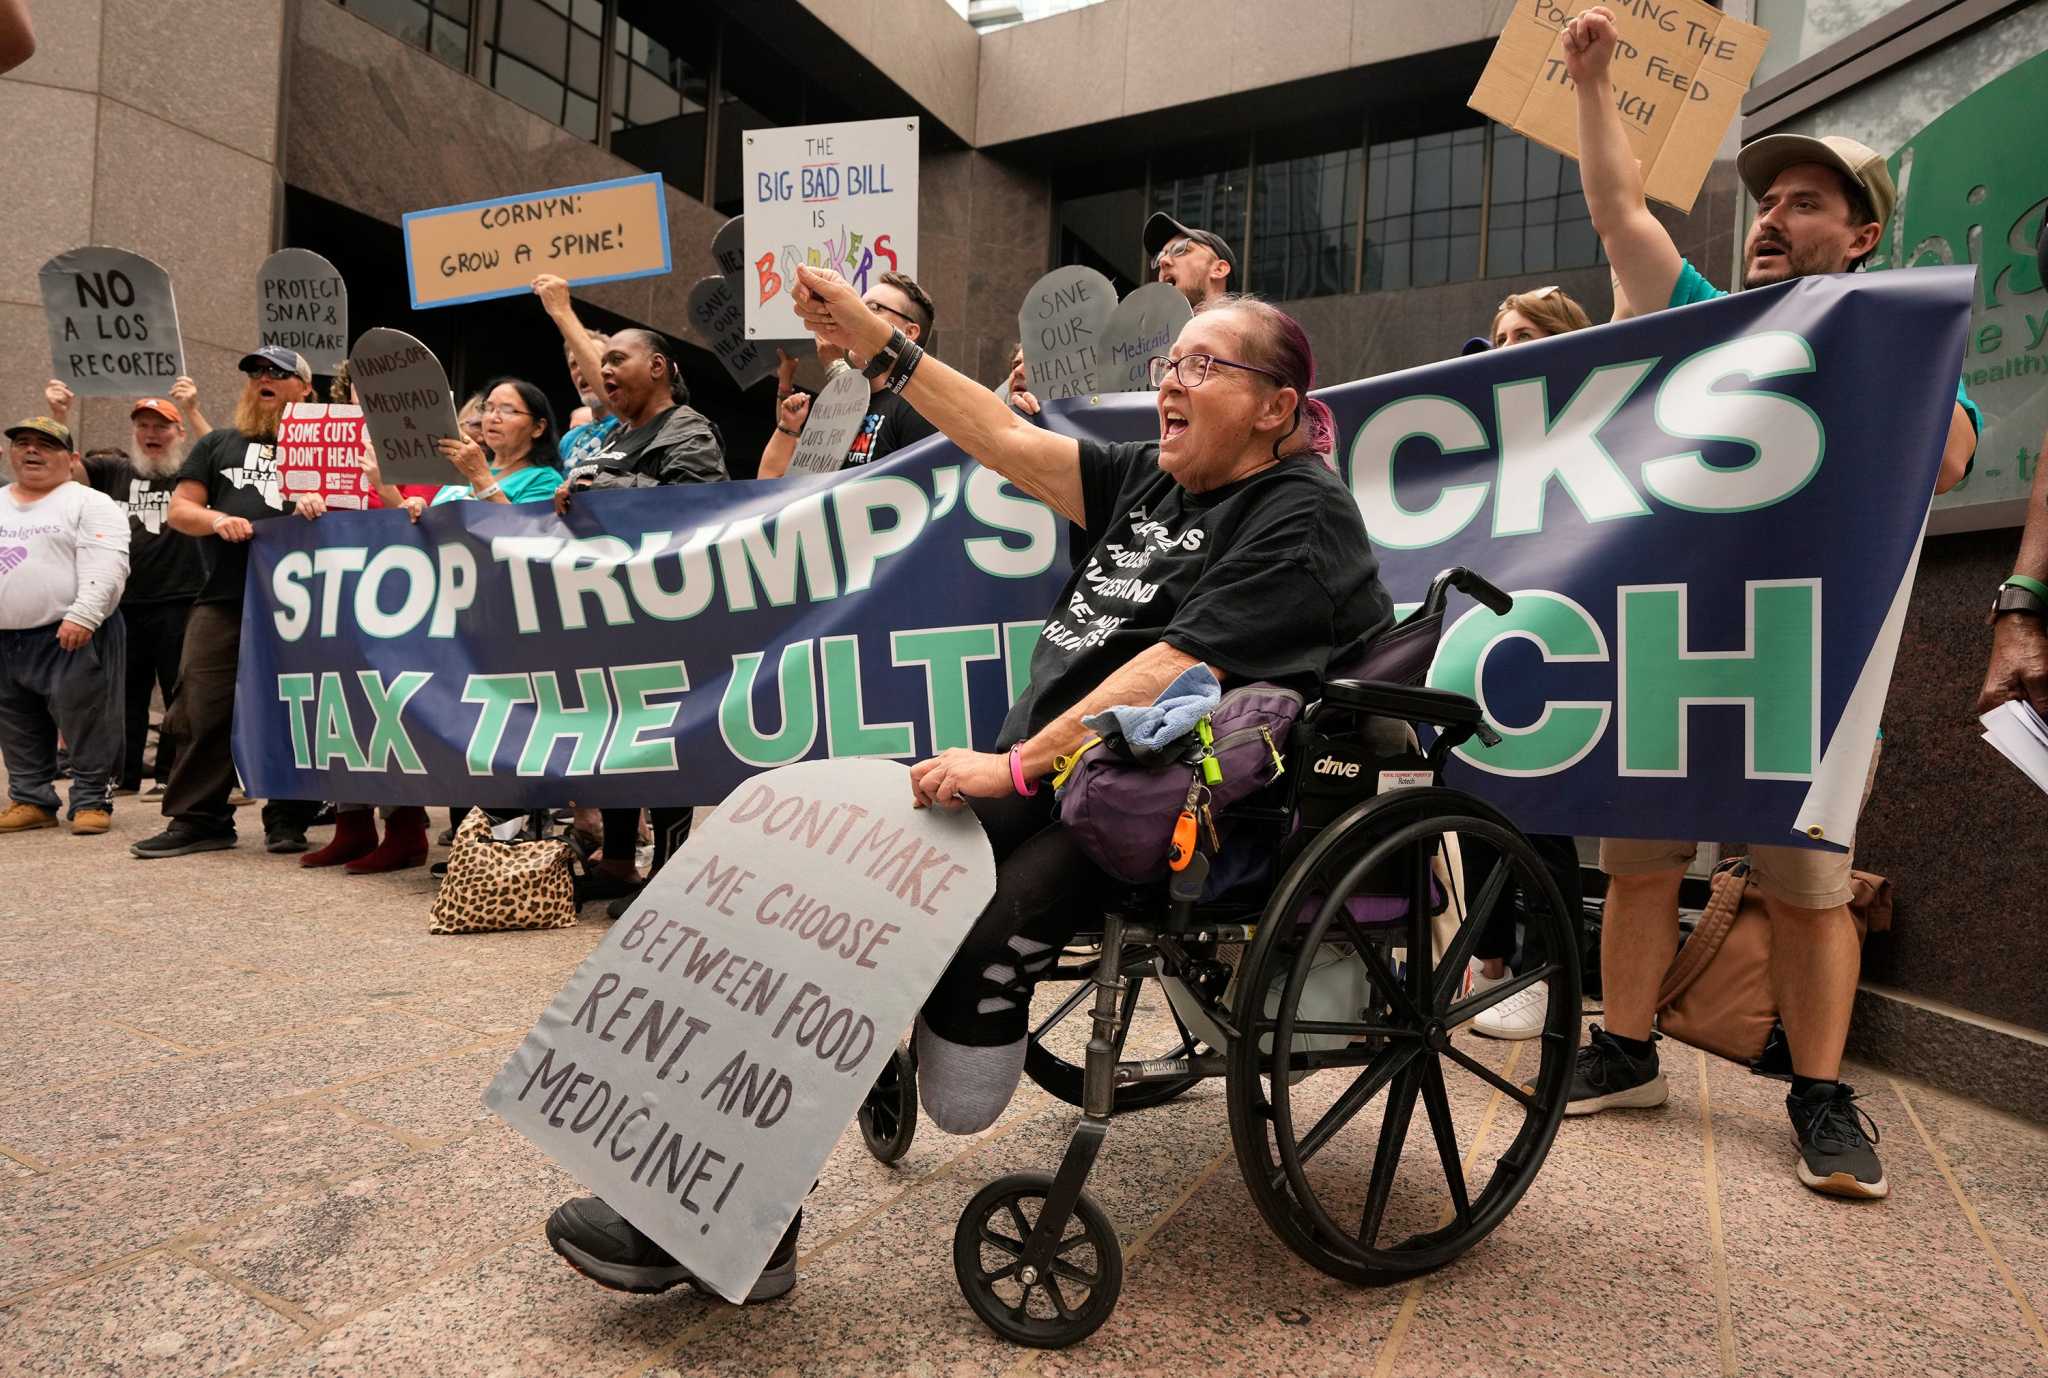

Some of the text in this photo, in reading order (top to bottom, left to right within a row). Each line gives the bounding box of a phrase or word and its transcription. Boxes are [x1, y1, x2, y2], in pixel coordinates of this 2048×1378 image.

[1617, 0, 1738, 61] ING THE
[1534, 0, 1710, 102] PO TO FEED
[1547, 58, 1657, 126] TH ICH
[805, 137, 834, 156] THE
[757, 164, 894, 202] BIG BAD BILL
[480, 195, 583, 230] CORNYN:
[812, 209, 826, 228] IS
[440, 223, 625, 277] GROW A SPINE!
[75, 269, 136, 309] NO
[264, 277, 341, 300] PROTECT
[696, 284, 733, 323] SAVE
[1038, 279, 1091, 320] SAVE
[64, 313, 148, 342] A LOS
[266, 302, 337, 325] SNAP &
[714, 305, 742, 333] OUR
[263, 331, 345, 350] MEDICARE
[1040, 315, 1093, 352] OUR
[1111, 323, 1170, 366] Medicaid
[69, 351, 177, 377] RECORTES
[354, 352, 407, 377] HANDS
[364, 388, 440, 414] MEDICAID
[1048, 372, 1096, 400] CARE
[286, 421, 357, 443] SOME CUTS
[403, 415, 417, 430] &
[288, 446, 324, 467] DON'T
[243, 471, 277, 480] TEXA
[272, 330, 1827, 641] STOP TRUMP'S CKS
[275, 669, 434, 776] TAX
[459, 659, 691, 778] THE
[1313, 755, 1361, 778] drive
[729, 783, 969, 917] DON'T MAKE
[685, 854, 901, 970] ME CHOOSE
[619, 908, 788, 1016] BETWEEN
[571, 972, 793, 1129] RENT, AND
[518, 1047, 745, 1236] MEDICINE!
